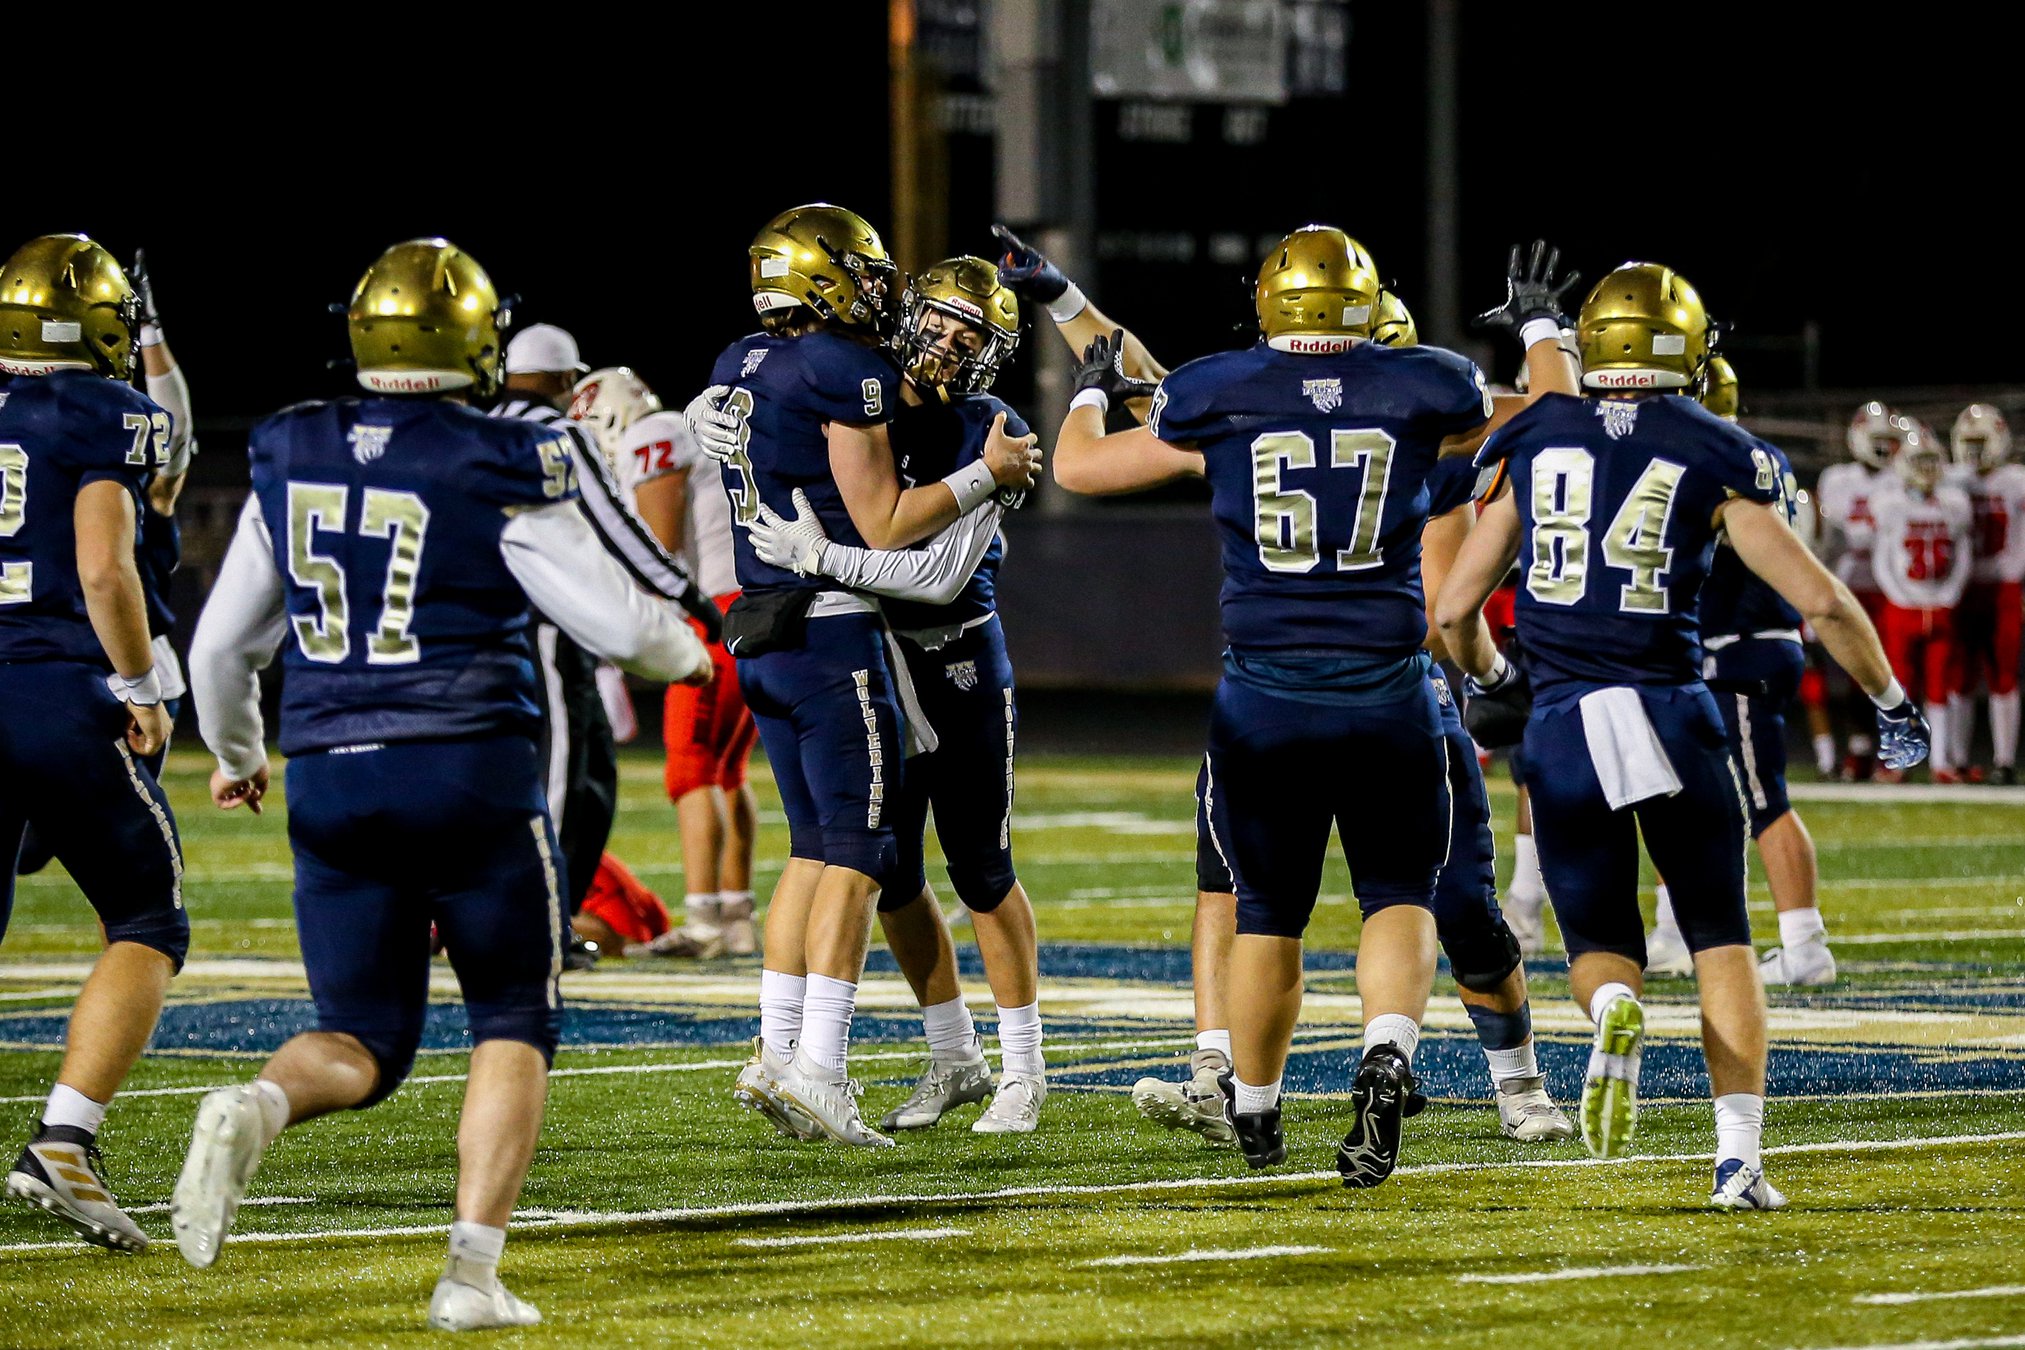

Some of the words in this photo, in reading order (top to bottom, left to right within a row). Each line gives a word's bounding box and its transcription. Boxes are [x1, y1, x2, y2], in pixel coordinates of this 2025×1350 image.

[1290, 339, 1353, 353] Riddell
[861, 377, 883, 417] 9
[123, 412, 174, 465] 72
[634, 440, 674, 473] 72
[1251, 427, 1396, 573] 67
[1526, 446, 1688, 614] 84
[287, 481, 431, 666] 57
